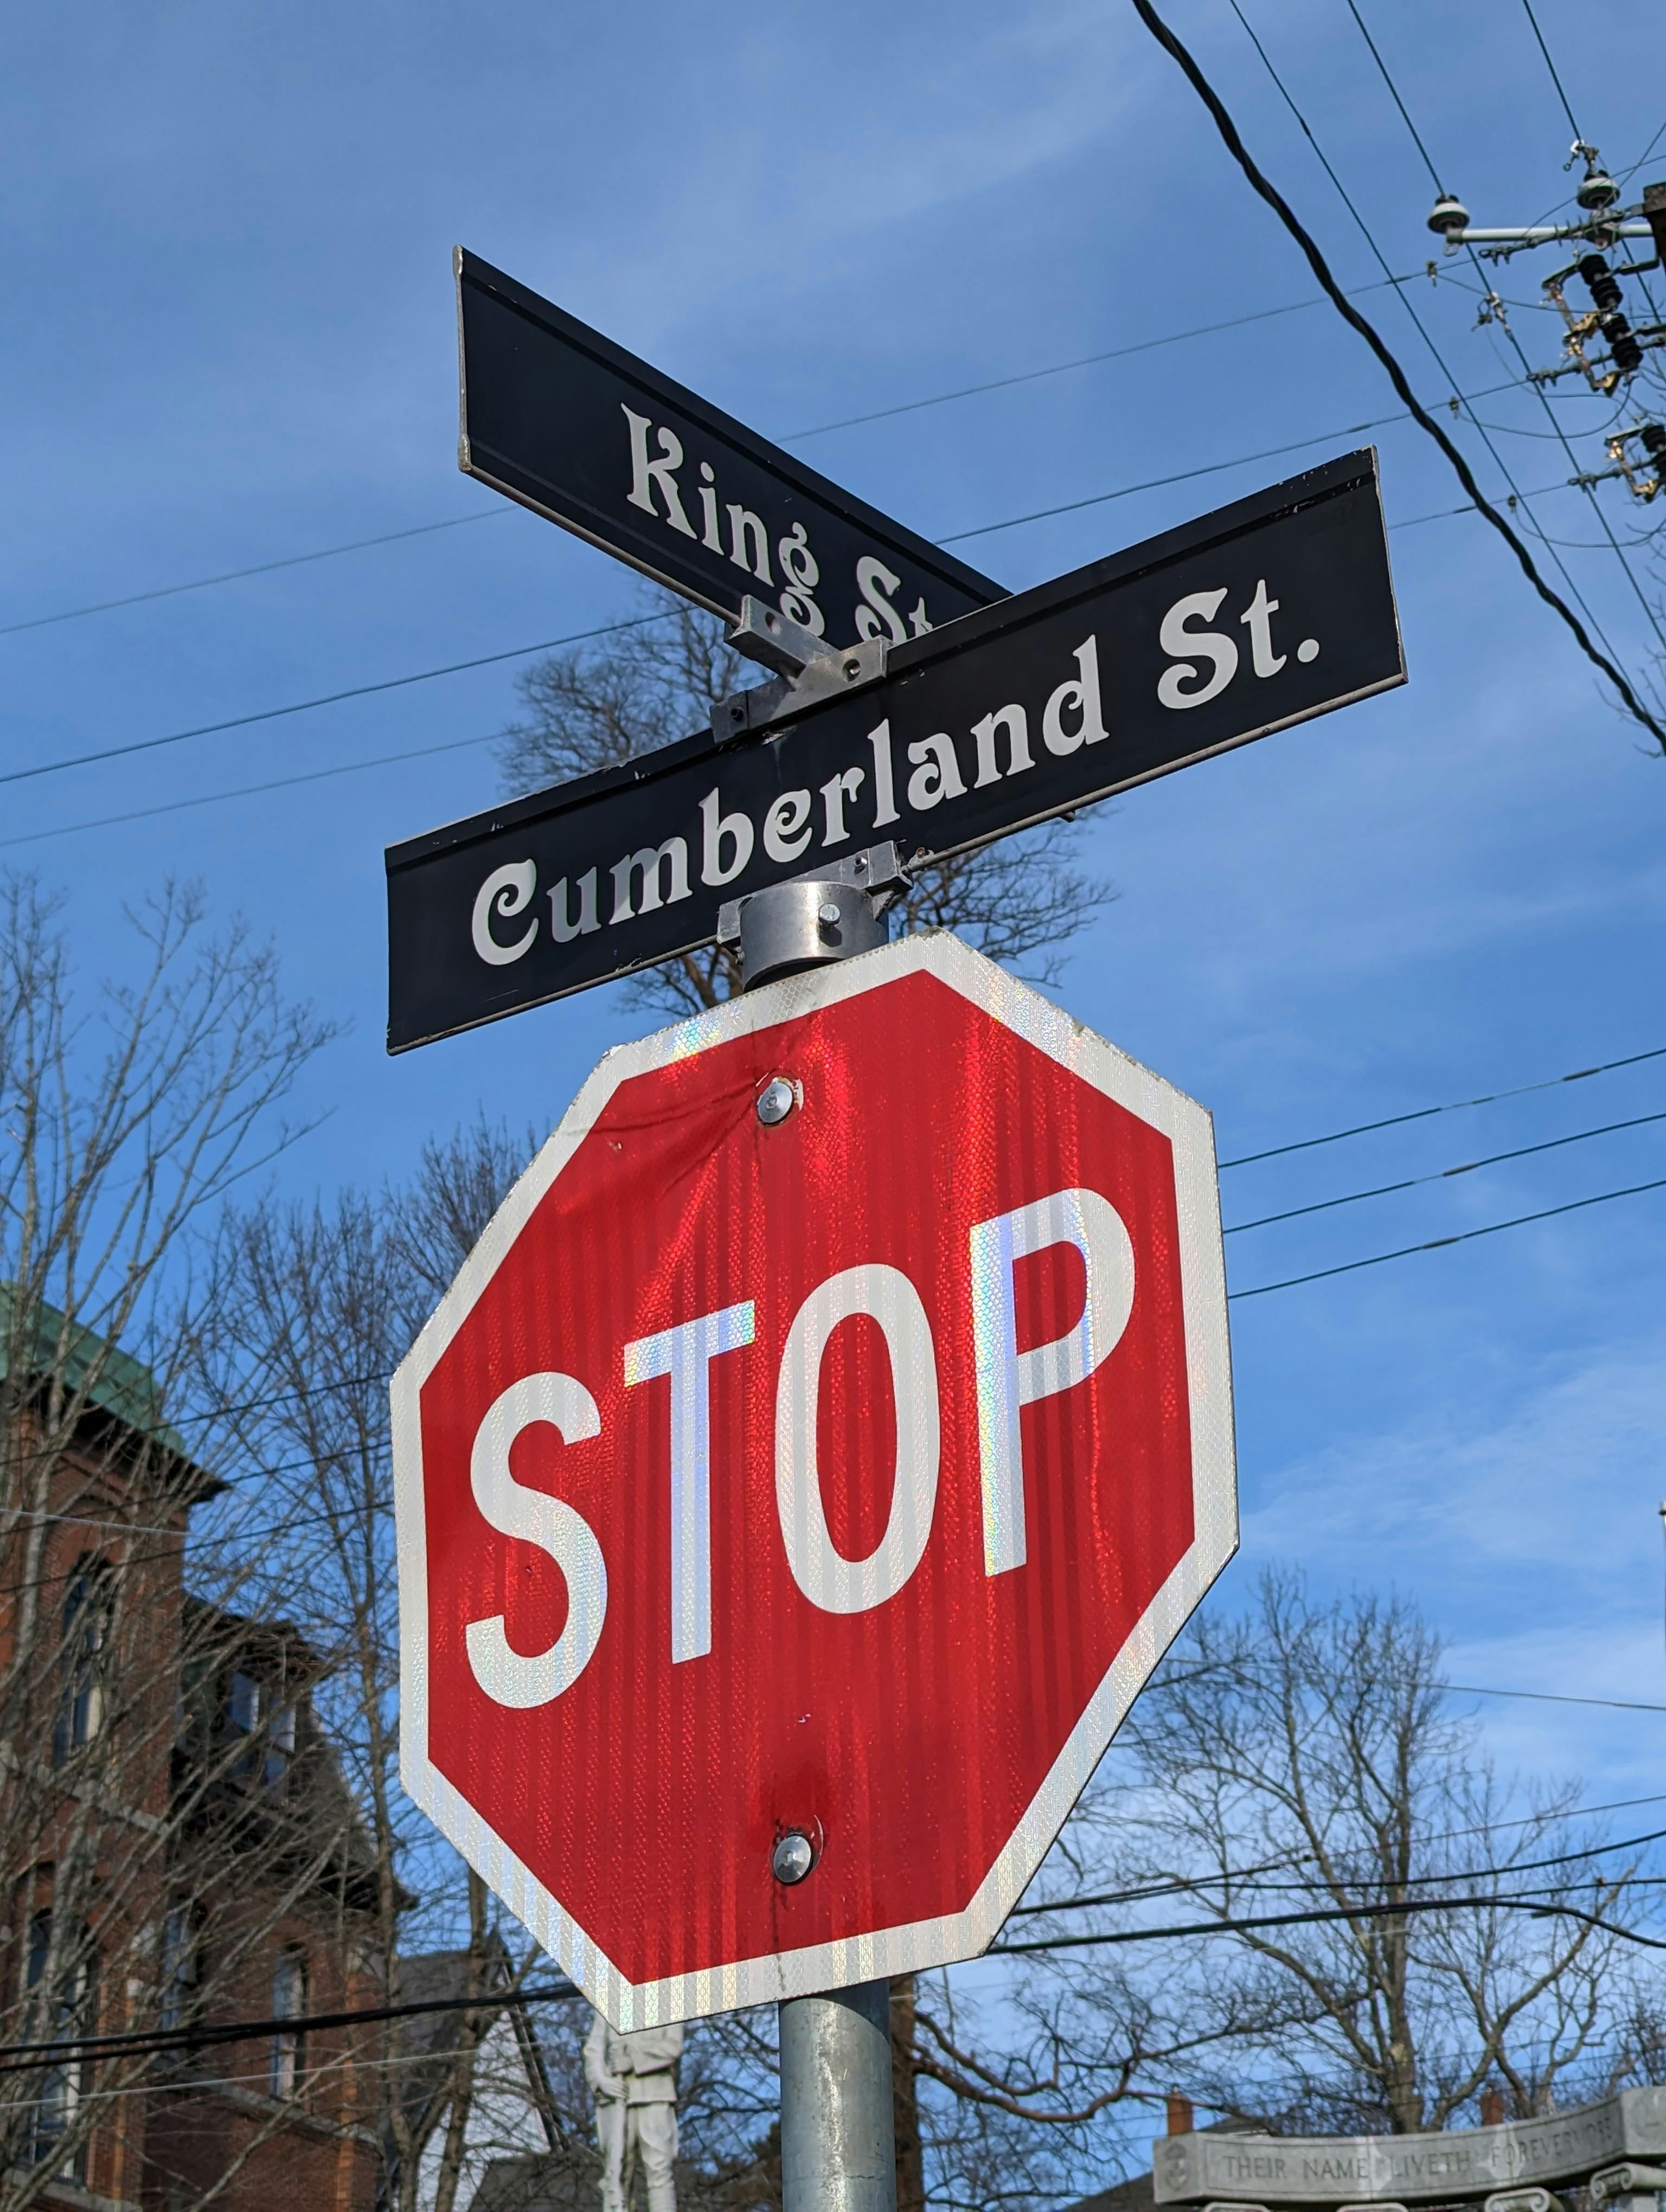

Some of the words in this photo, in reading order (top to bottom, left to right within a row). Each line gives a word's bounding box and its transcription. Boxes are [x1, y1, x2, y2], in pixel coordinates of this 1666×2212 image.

[620, 402, 825, 638] King
[472, 634, 1110, 967] Cumberland
[1157, 579, 1319, 709] St.
[465, 1187, 1135, 1709] STOP
[1223, 2155, 1288, 2179] THEIR
[1302, 2157, 1369, 2179] NAME
[1390, 2150, 1471, 2177] LIVETH
